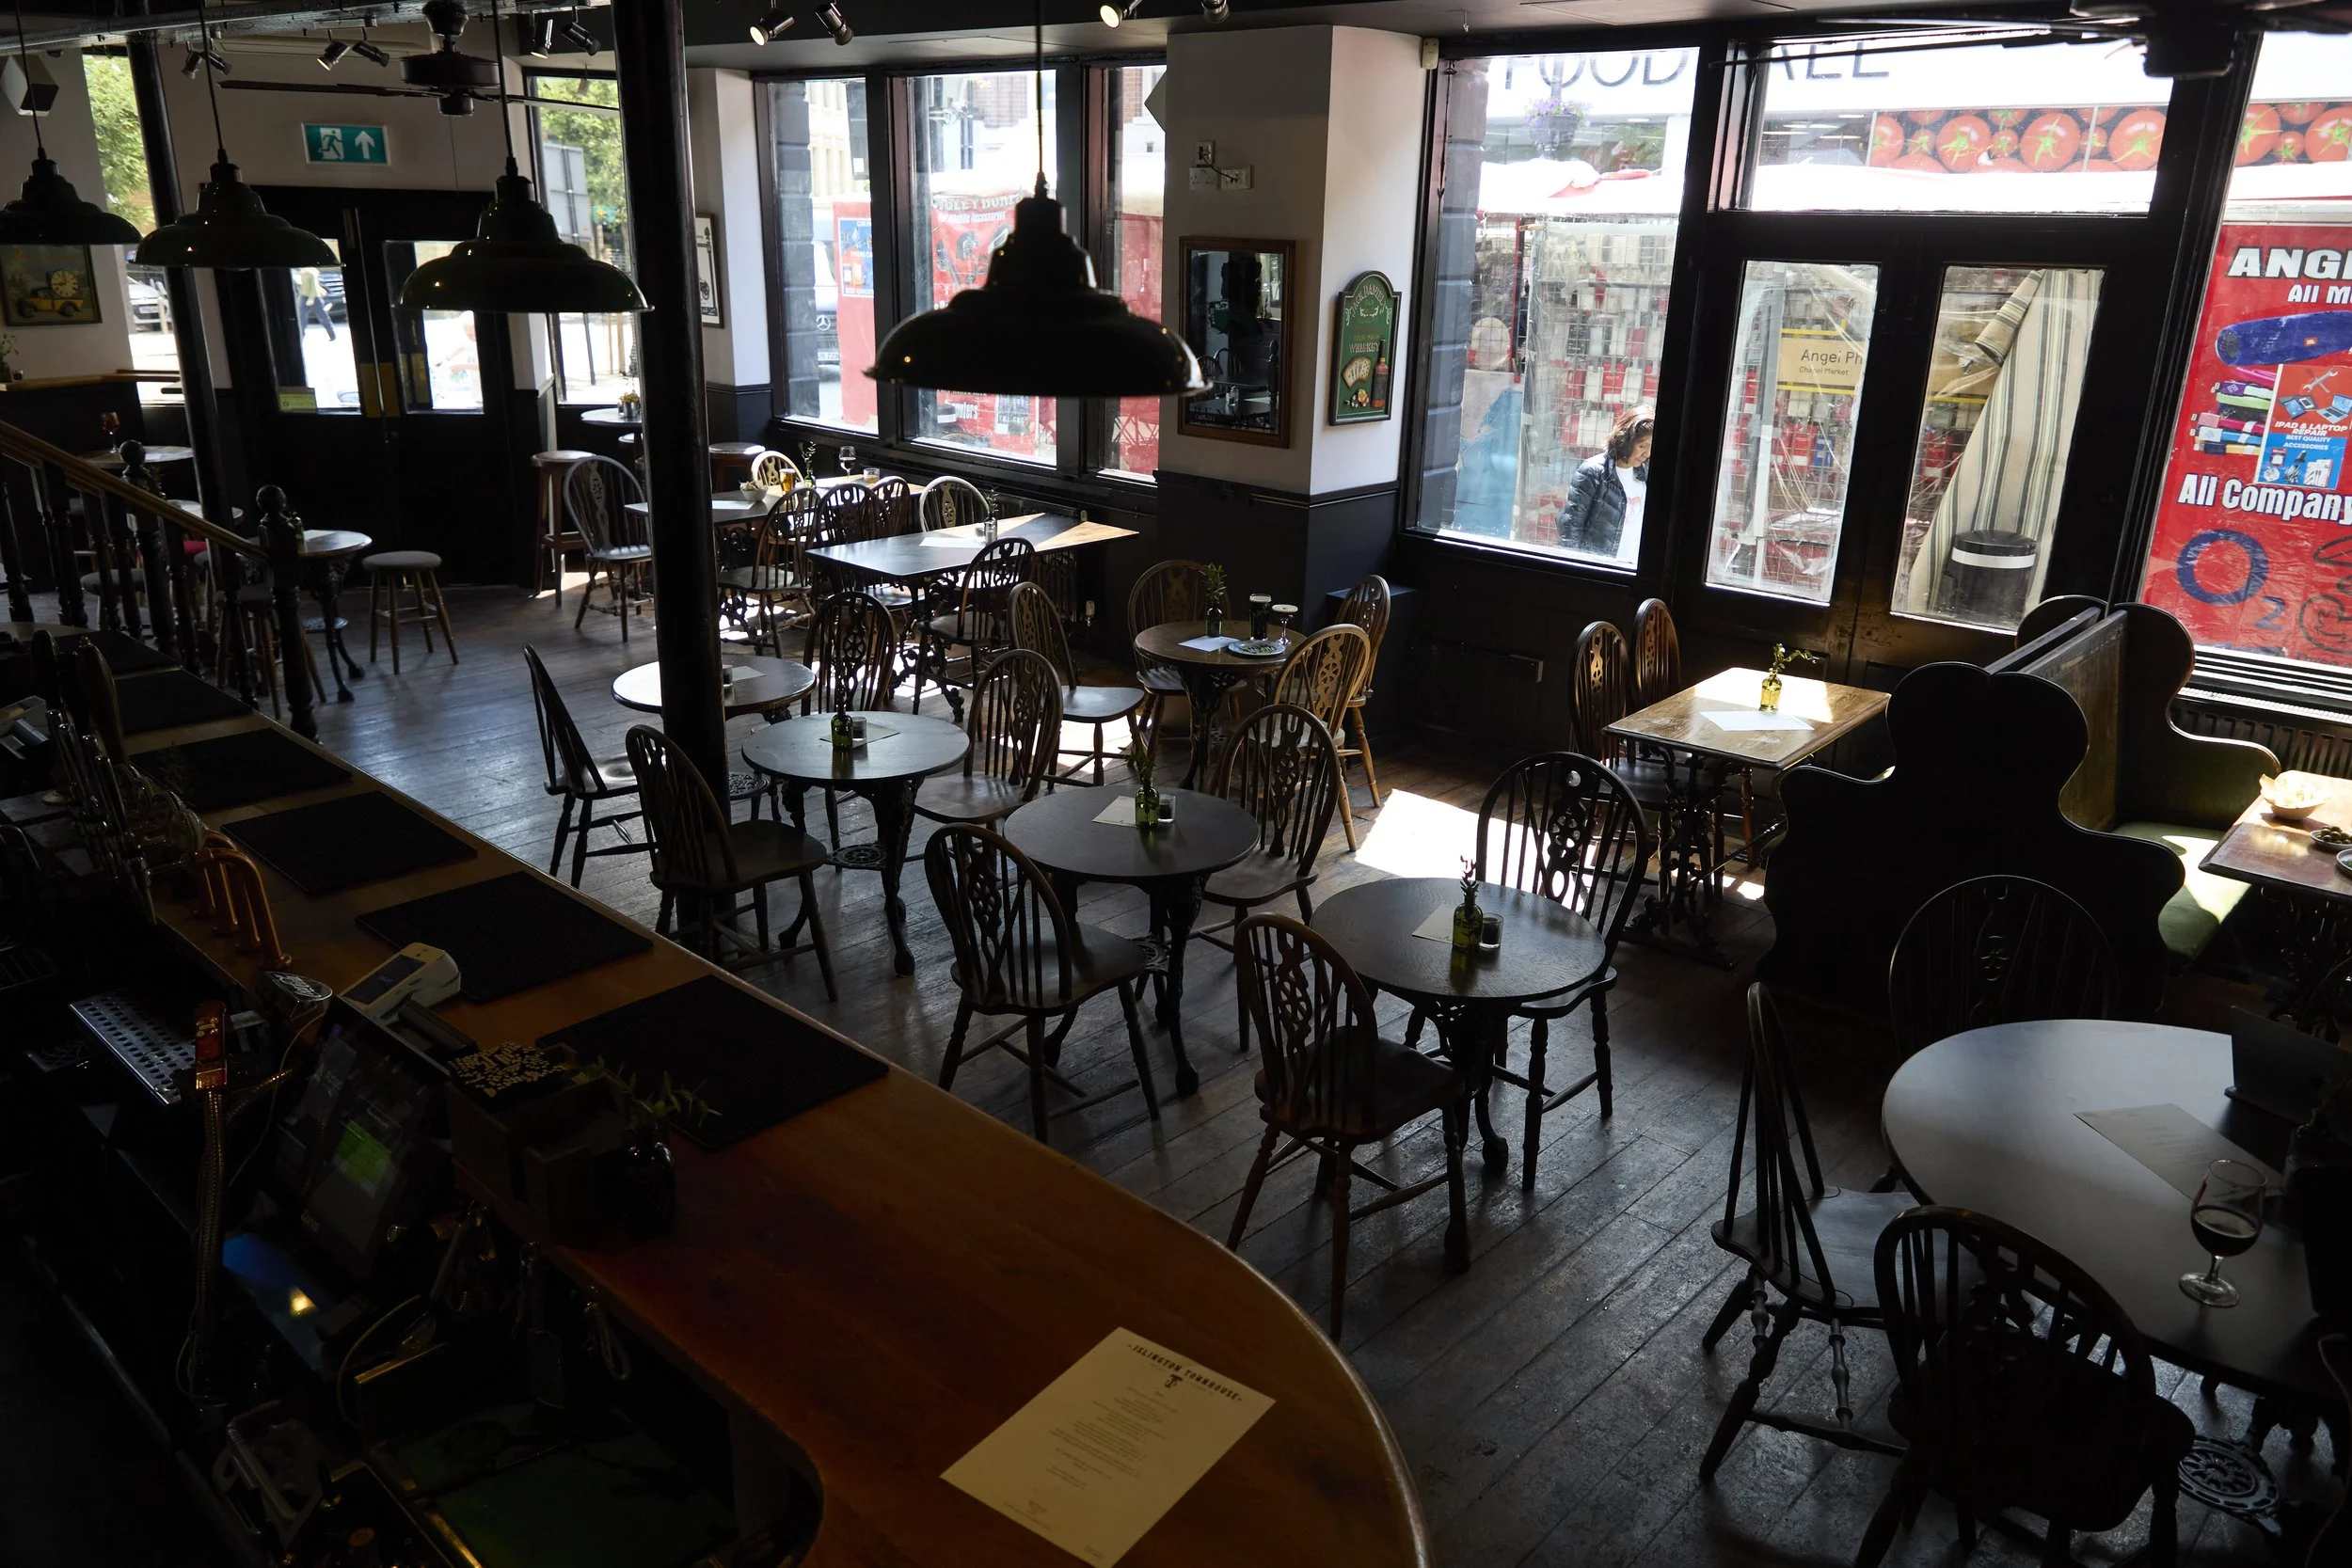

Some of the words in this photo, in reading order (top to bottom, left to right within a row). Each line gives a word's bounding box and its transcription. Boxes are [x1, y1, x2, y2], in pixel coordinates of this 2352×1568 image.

[2287, 284, 2320, 303] All
[2326, 285, 2352, 304] M
[1349, 341, 1380, 354] WHISKEY
[1824, 368, 1850, 376] Market
[2275, 420, 2299, 430] IPAD
[2309, 422, 2348, 433] LAPTOP
[2292, 428, 2328, 436] REPAIR
[2283, 442, 2328, 451] ACCESSORIES
[2177, 473, 2218, 506] All
[2221, 478, 2352, 526] Company
[1133, 1344, 1183, 1372] ISLINGTON
[1184, 1369, 1239, 1401] TOWNHOUSE
